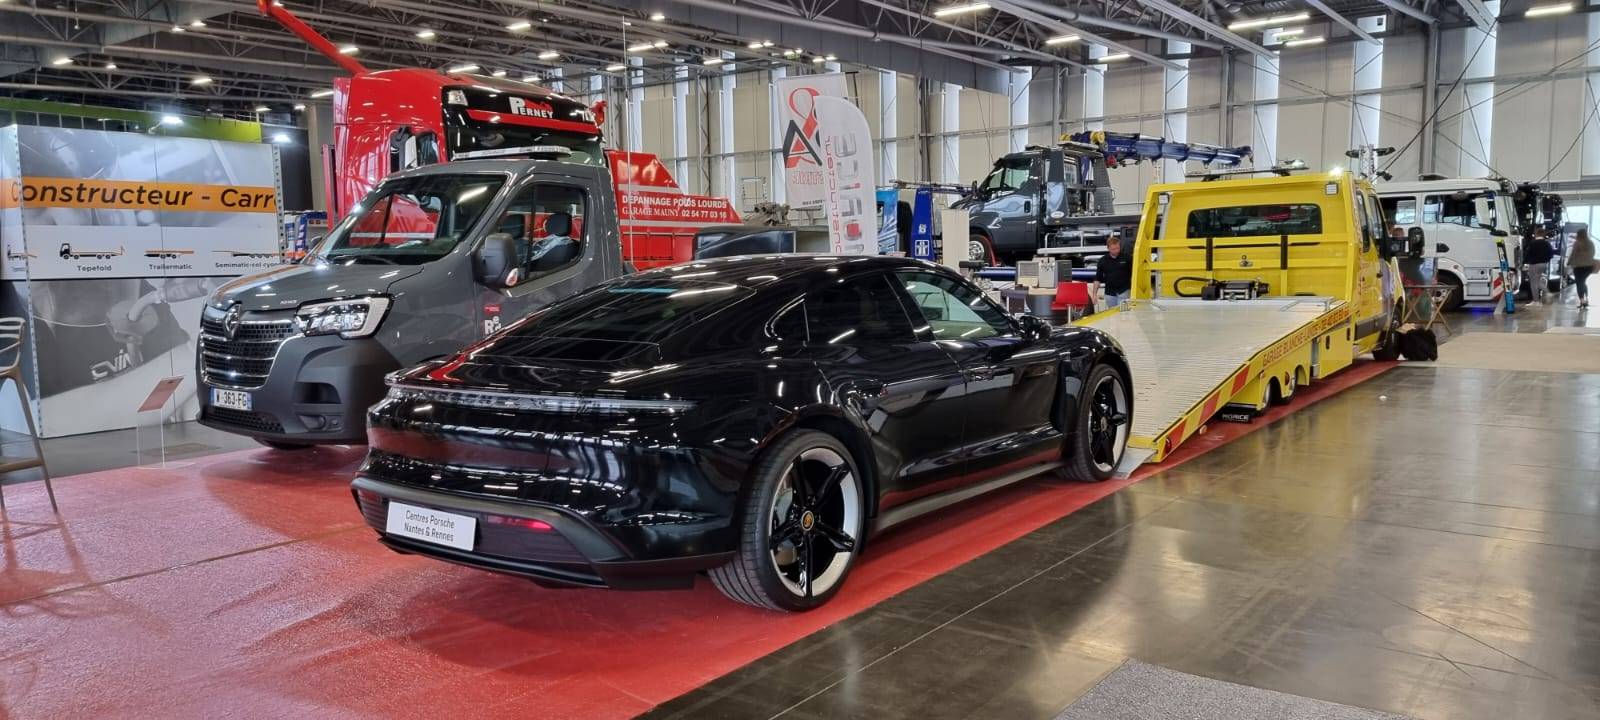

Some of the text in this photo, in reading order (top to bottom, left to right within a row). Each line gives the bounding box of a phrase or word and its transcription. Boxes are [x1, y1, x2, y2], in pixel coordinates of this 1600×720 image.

[698, 200, 727, 209] LOURDS
[622, 206, 653, 217] GARAGE
[654, 207, 681, 217] MAUNY
[681, 209, 690, 217] 02
[691, 210, 700, 218] 54
[701, 210, 709, 218] 77
[710, 210, 718, 218] 03
[149, 263, 193, 271] Trailermatic
[405, 510, 455, 529] Centres Porsche
[404, 522, 454, 542] Nantes & Rennes
